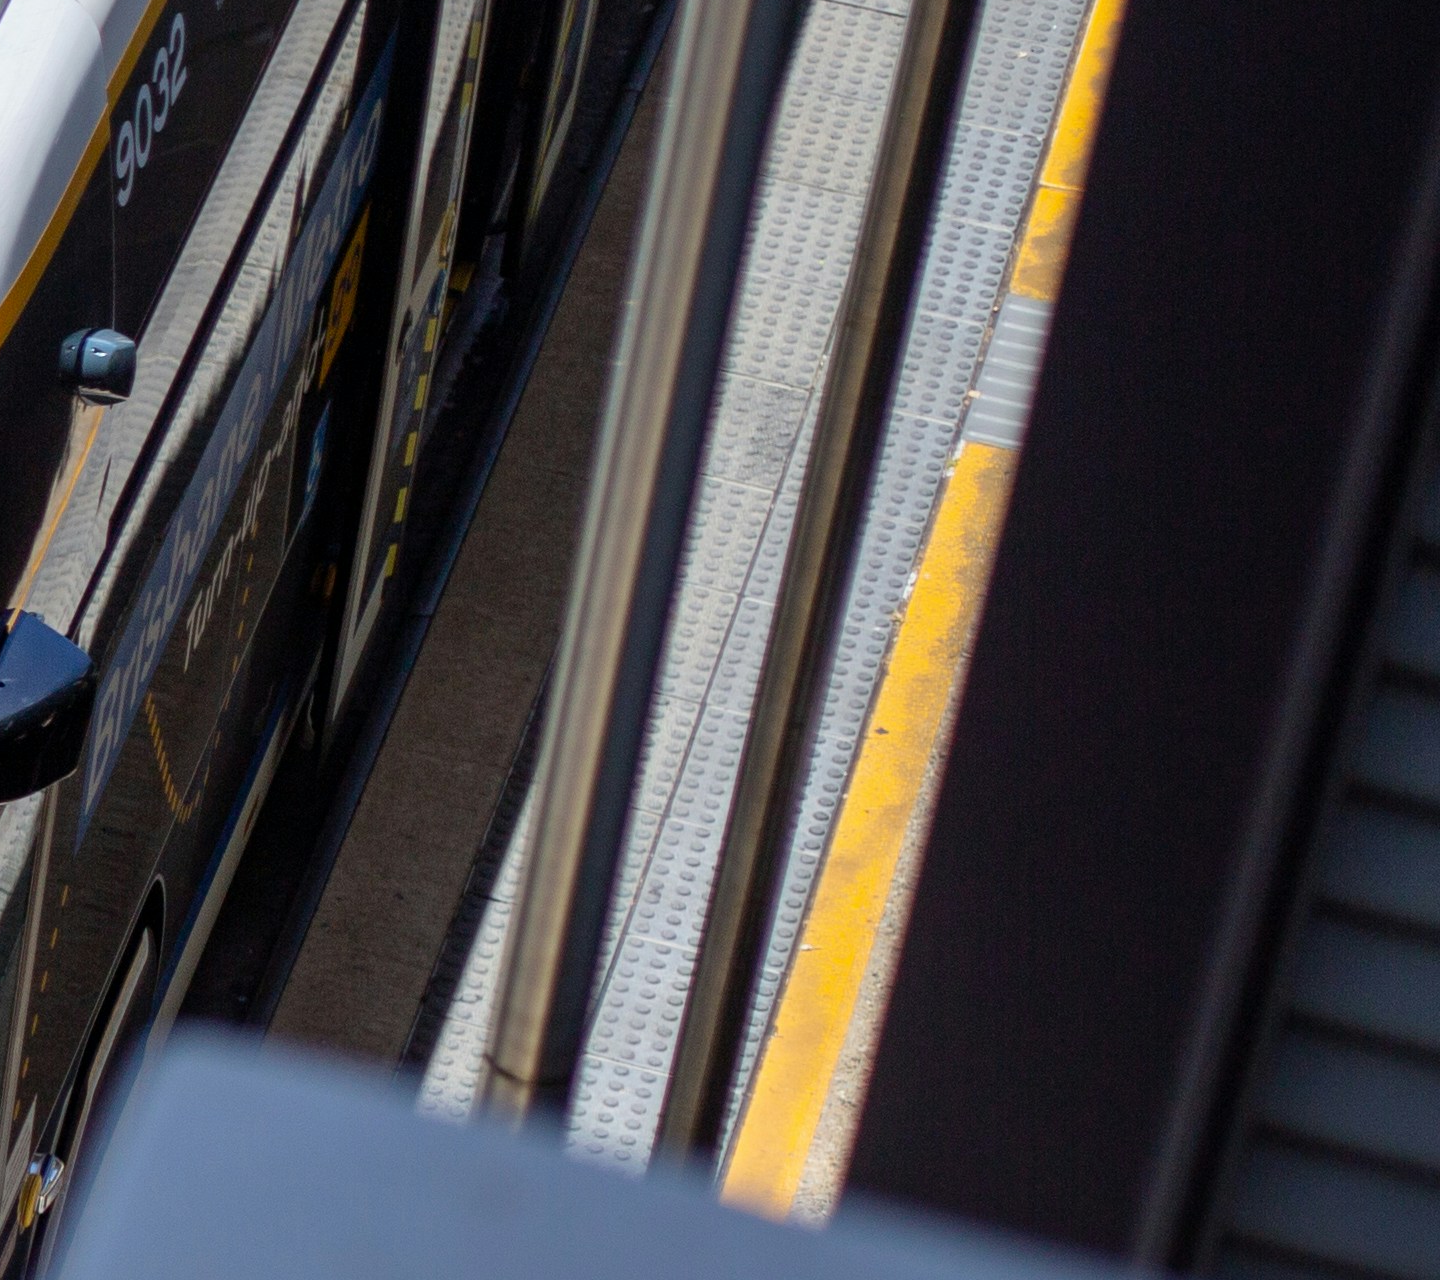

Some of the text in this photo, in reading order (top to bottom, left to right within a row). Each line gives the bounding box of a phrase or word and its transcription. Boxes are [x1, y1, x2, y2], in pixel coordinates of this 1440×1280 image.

[114, 12, 187, 207] 9032
[84, 98, 382, 815] Brisbane Metro
